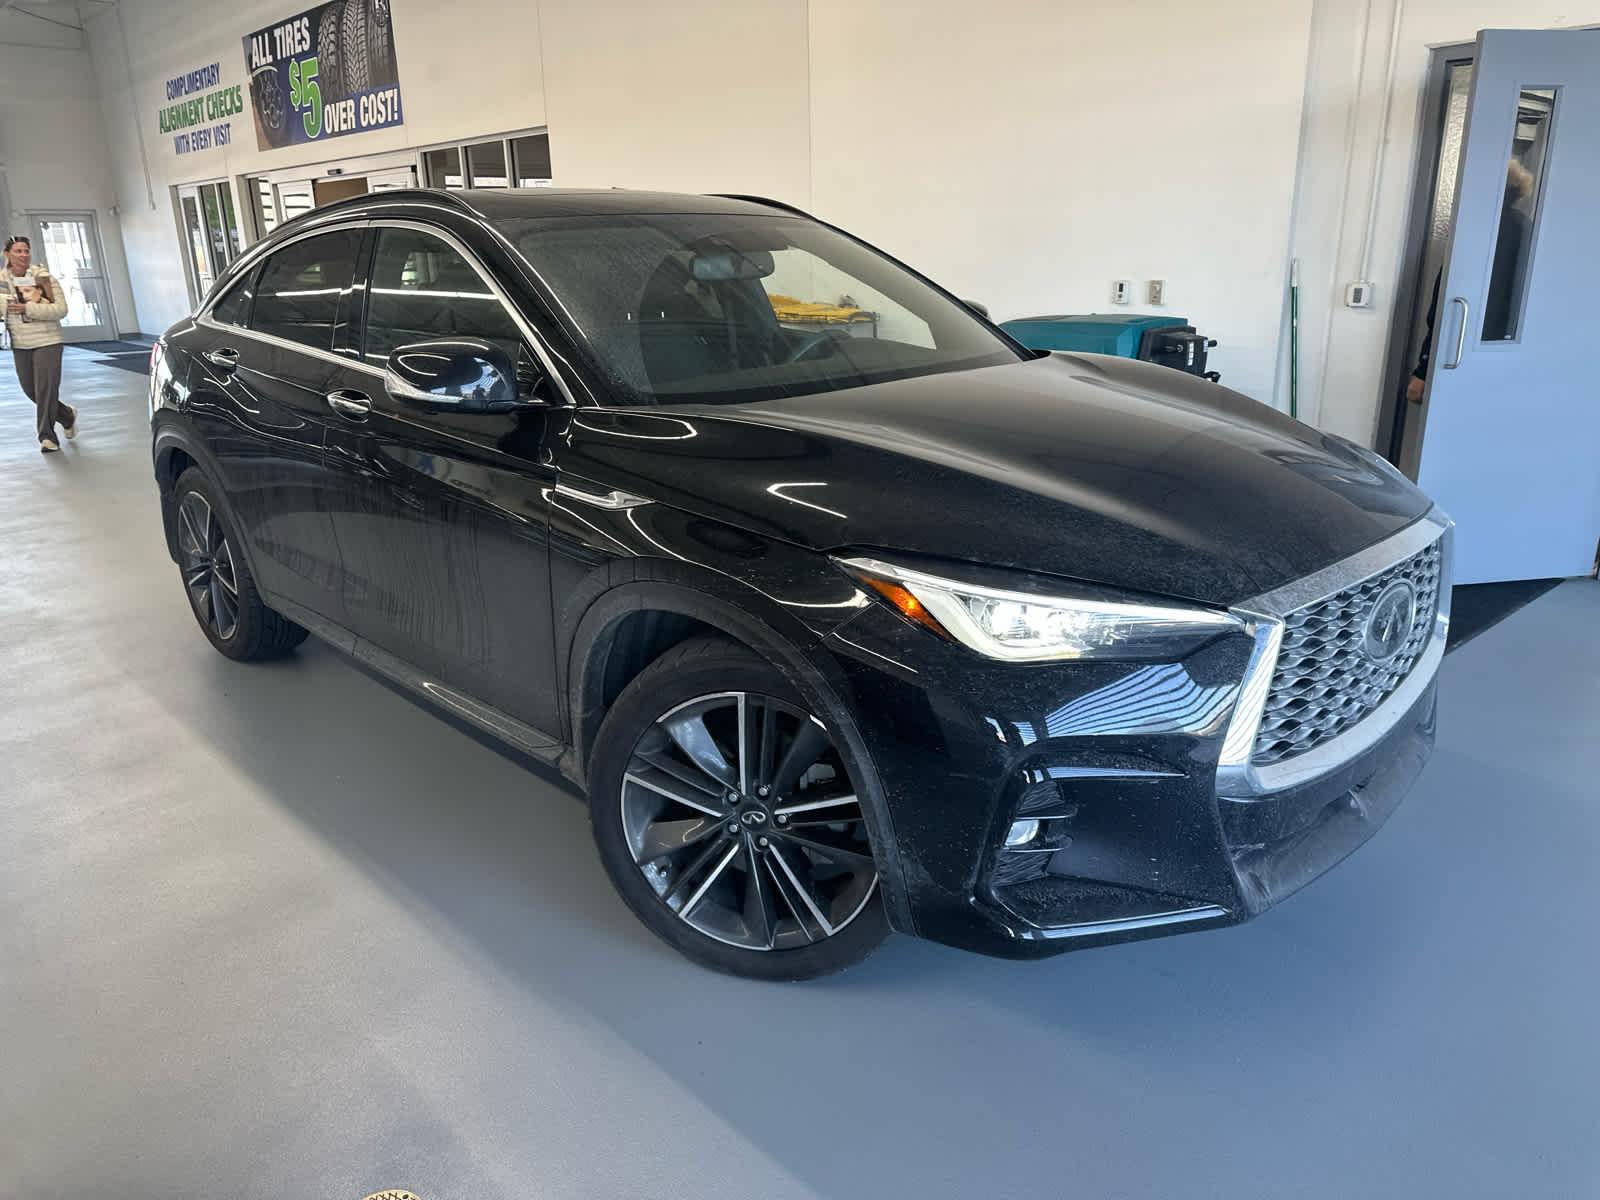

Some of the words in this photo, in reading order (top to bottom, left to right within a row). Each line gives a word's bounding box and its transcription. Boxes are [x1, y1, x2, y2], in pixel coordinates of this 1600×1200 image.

[252, 32, 273, 69] ALL
[274, 16, 311, 60] TIRES
[166, 62, 220, 101] COMPLIMENTARY
[288, 57, 323, 139] $5
[159, 96, 205, 134] ALIGNMENT
[205, 85, 243, 121] CHECKS
[324, 99, 356, 135] OVER
[360, 88, 398, 127] COST!
[174, 133, 191, 155] WITH
[191, 127, 212, 151] EVERY
[212, 122, 231, 147] VISIT
